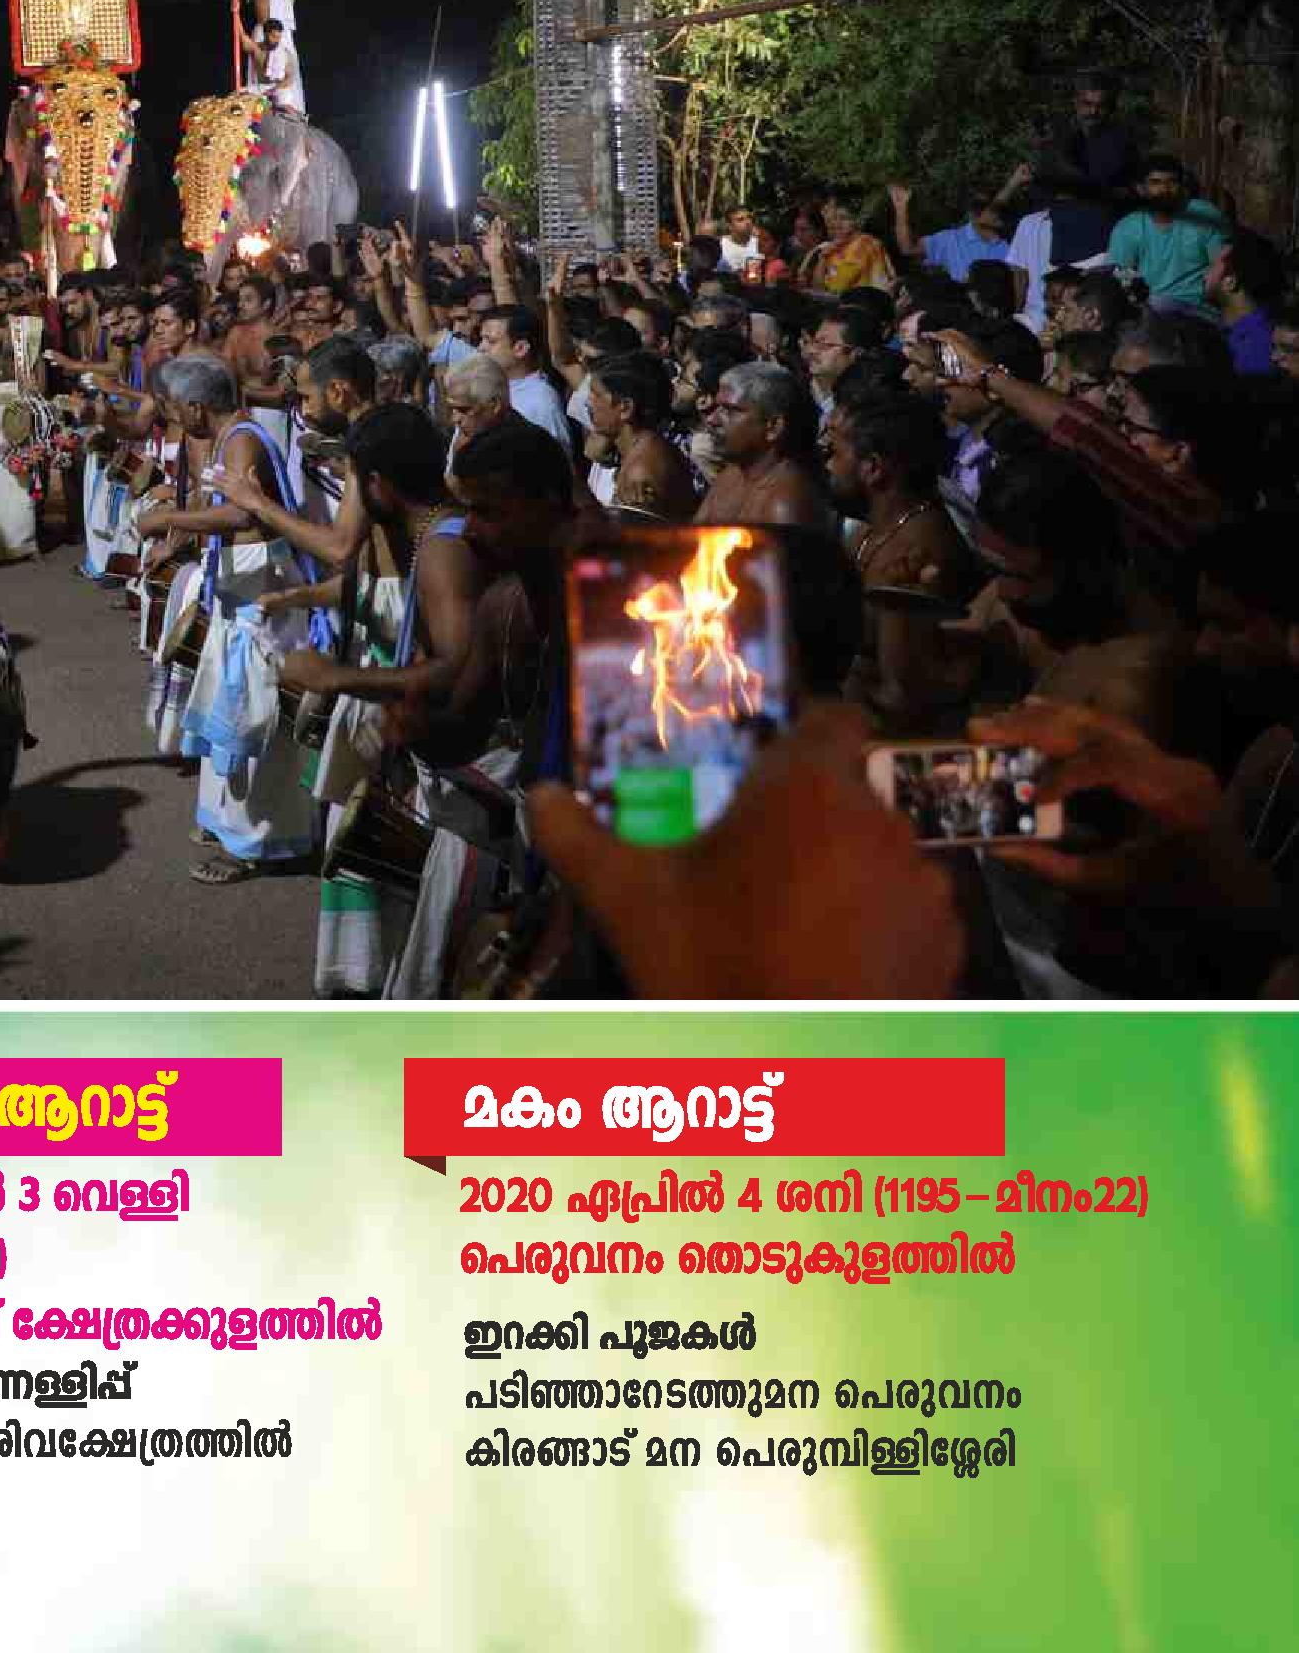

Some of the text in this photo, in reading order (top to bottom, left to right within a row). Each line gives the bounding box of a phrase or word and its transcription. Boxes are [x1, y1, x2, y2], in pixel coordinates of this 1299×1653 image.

[464, 1072, 784, 1142] മകം ആറാട്ട്
[19, 1176, 40, 1211] 3
[54, 1169, 189, 1221] വെള്ളി
[461, 1177, 552, 1212] 2020
[568, 1169, 724, 1223] ഏപ്രിൽ
[738, 1178, 762, 1212] 4
[777, 1170, 862, 1212] ശനി
[461, 1231, 1015, 1284] പെരുവനം തൊടുകുളത്തിൽ
[12, 1297, 382, 1350] ക്ഷേത്രക്കുളത്തിൽ
[464, 1311, 756, 1359] ഇറക്കി പൂജകൾ
[466, 1369, 1021, 1418] പടിഞ്ഞാറേടത്തുമന പെരുവനം
[466, 1428, 1015, 1478] കിരങ്ങാട് മന പെരുമ്പിള്ളിശ്ശേരി
